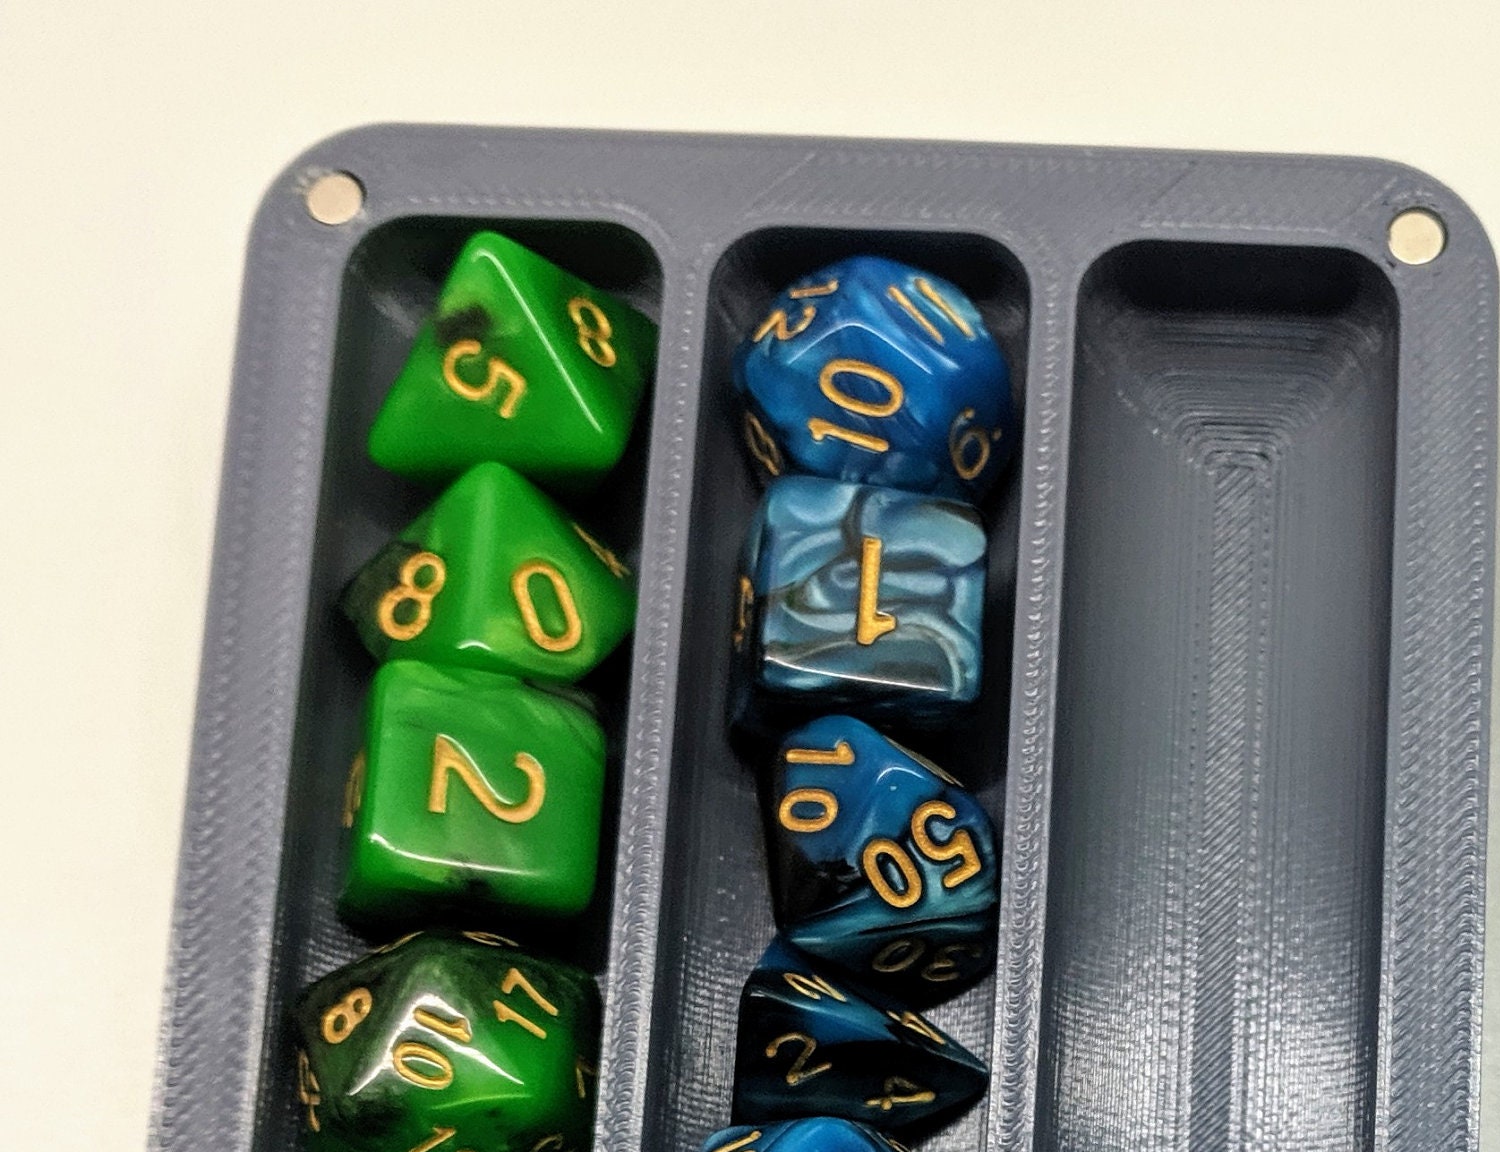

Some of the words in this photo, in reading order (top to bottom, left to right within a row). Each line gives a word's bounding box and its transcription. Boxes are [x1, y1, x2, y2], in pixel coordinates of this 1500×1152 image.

[568, 296, 616, 367] 8
[888, 277, 976, 345] 11
[443, 338, 527, 419] 5
[808, 358, 904, 453] 10
[377, 552, 447, 641] 8
[511, 557, 582, 652] 0
[857, 536, 897, 645] 1
[428, 734, 546, 823] 2
[778, 740, 855, 833] 10
[861, 799, 983, 909] 50
[321, 987, 372, 1045] 8
[492, 967, 559, 1040] 17
[393, 1008, 472, 1090] 10
[764, 1032, 833, 1086] 2
